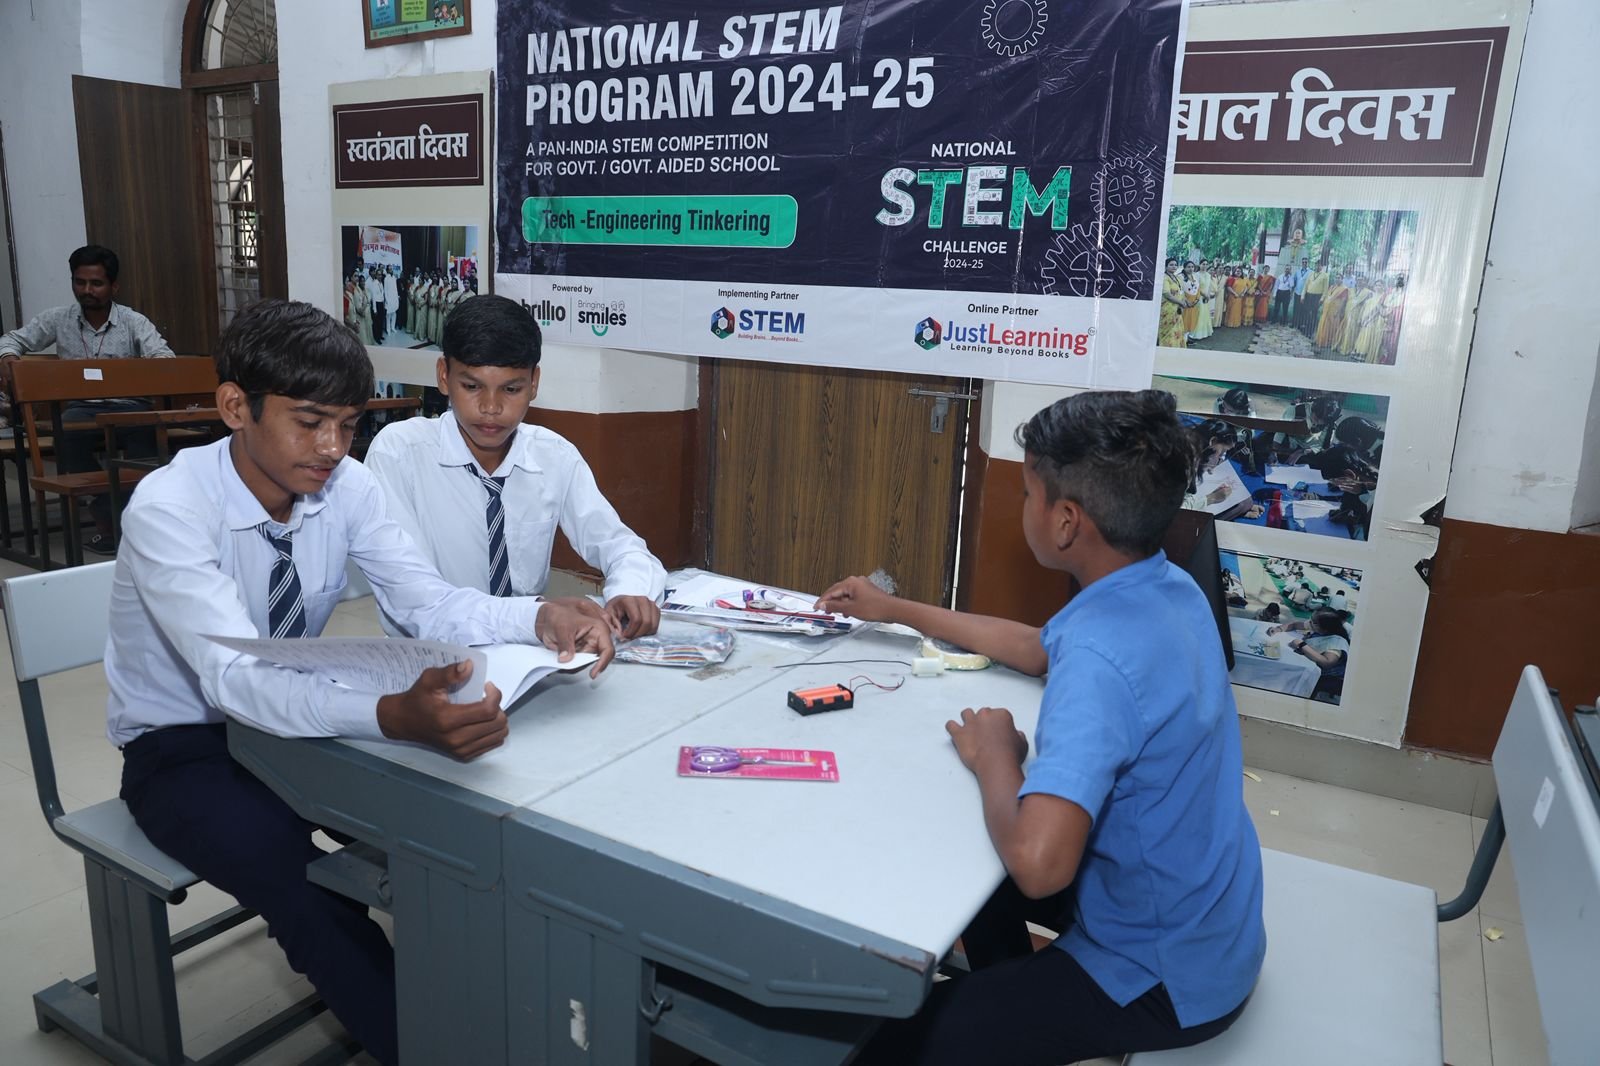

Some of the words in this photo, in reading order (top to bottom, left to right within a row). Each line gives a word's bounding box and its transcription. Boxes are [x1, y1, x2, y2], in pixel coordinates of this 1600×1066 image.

[526, 19, 703, 75] NATIONAL
[718, 5, 844, 61] STEM
[525, 70, 714, 126] PROGRAM
[730, 57, 936, 116] 2024-25
[1175, 92, 1279, 142] बाल
[1286, 67, 1456, 146] दिवस
[346, 130, 418, 163] स्वतंत्रता
[418, 123, 469, 160] दिवस
[526, 142, 536, 156] A
[538, 138, 608, 156] PAN-INDIA
[612, 137, 653, 153] STEM
[657, 132, 769, 152] COMPETITION
[931, 140, 1016, 158] NATIONAL
[525, 161, 553, 176] FOR
[556, 159, 598, 176] GOVT.
[609, 158, 653, 174] GOVT.
[657, 157, 705, 174] AIDED
[709, 155, 781, 173] SCHOOL
[875, 165, 1072, 230] STEM
[542, 209, 575, 230] Tech
[688, 208, 770, 236] Tinkering
[922, 239, 1007, 255] CHALLENGE
[943, 258, 984, 270] 2024-25
[552, 283, 582, 293] Powered
[584, 285, 593, 295] by
[718, 288, 769, 300] Implementing
[770, 290, 799, 300] Partner
[577, 299, 606, 311] Bringing
[967, 303, 999, 314] Online
[1002, 305, 1039, 316] Partner
[578, 307, 627, 326] smiles
[739, 308, 805, 334] STEM
[942, 320, 1089, 356] JustLearning
[950, 343, 993, 354] Learning
[997, 346, 1034, 356] Beyond
[1037, 350, 1070, 359] Books
